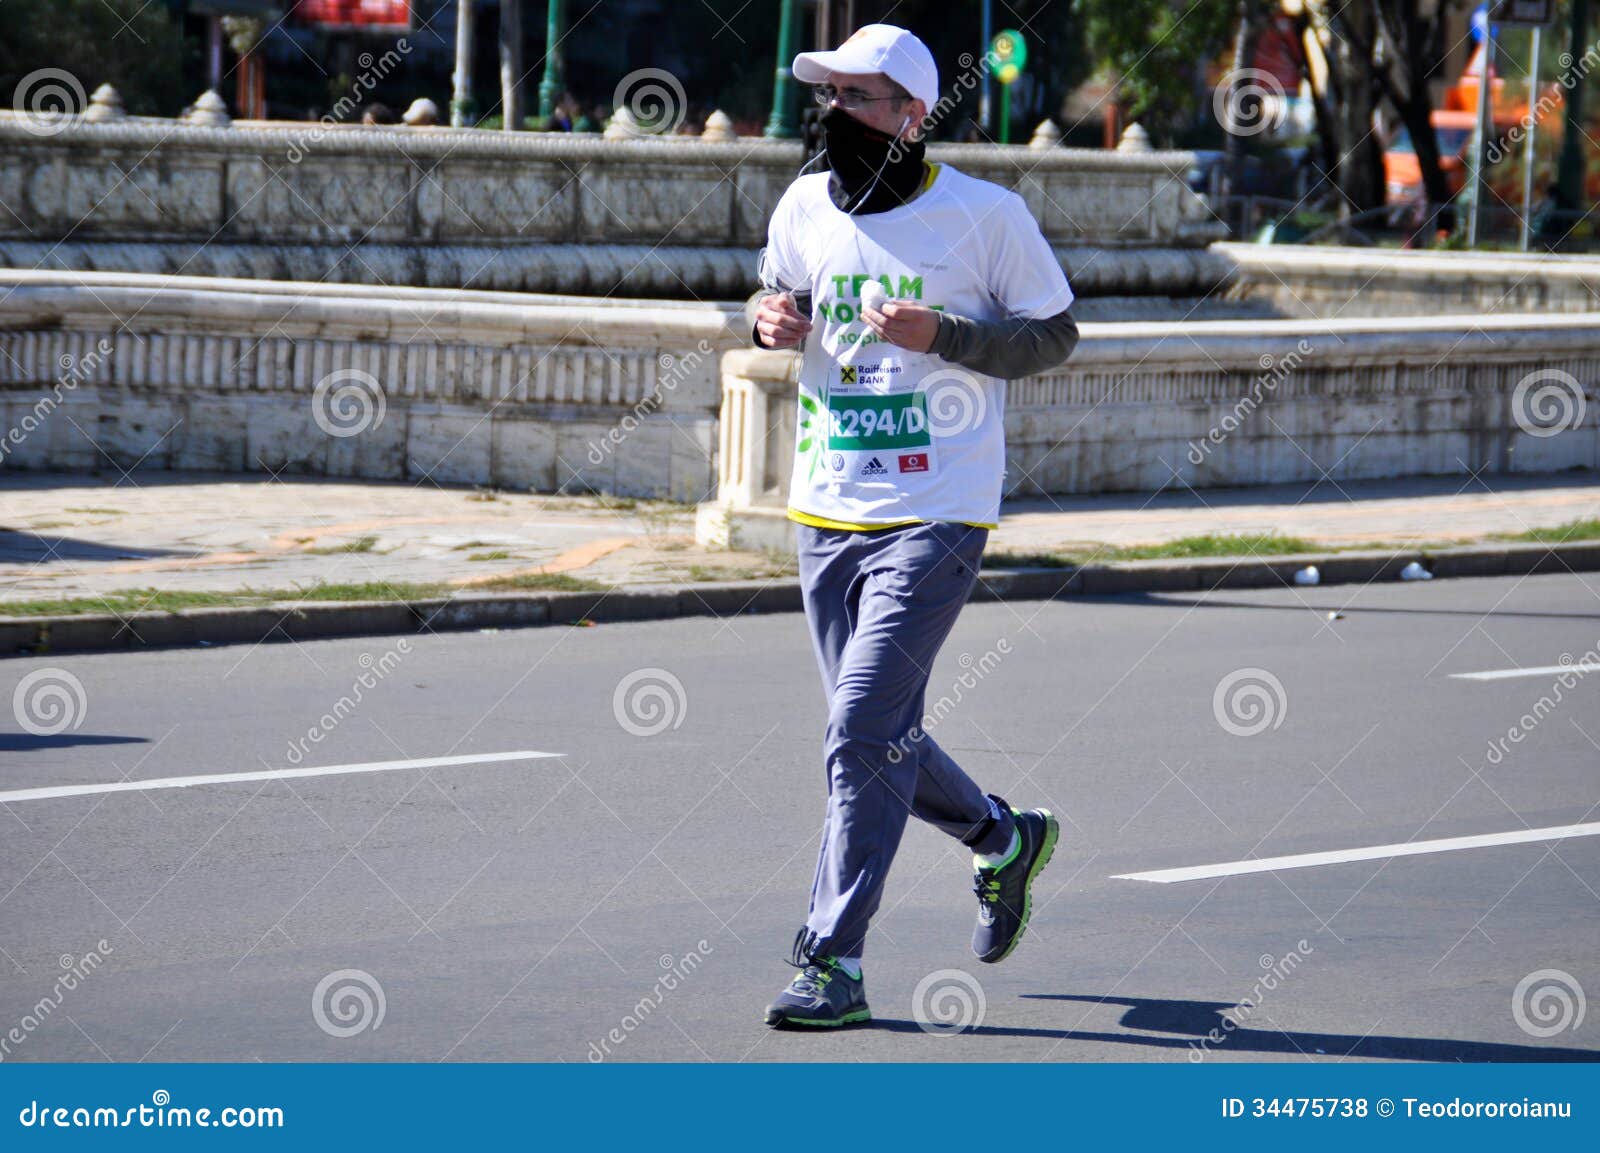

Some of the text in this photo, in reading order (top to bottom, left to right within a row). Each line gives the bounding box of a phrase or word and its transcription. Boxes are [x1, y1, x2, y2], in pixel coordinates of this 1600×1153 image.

[858, 364, 902, 374] Raiffeisen
[859, 375, 885, 385] BANK
[829, 406, 924, 437] R294/D
[861, 467, 888, 476] adidas
